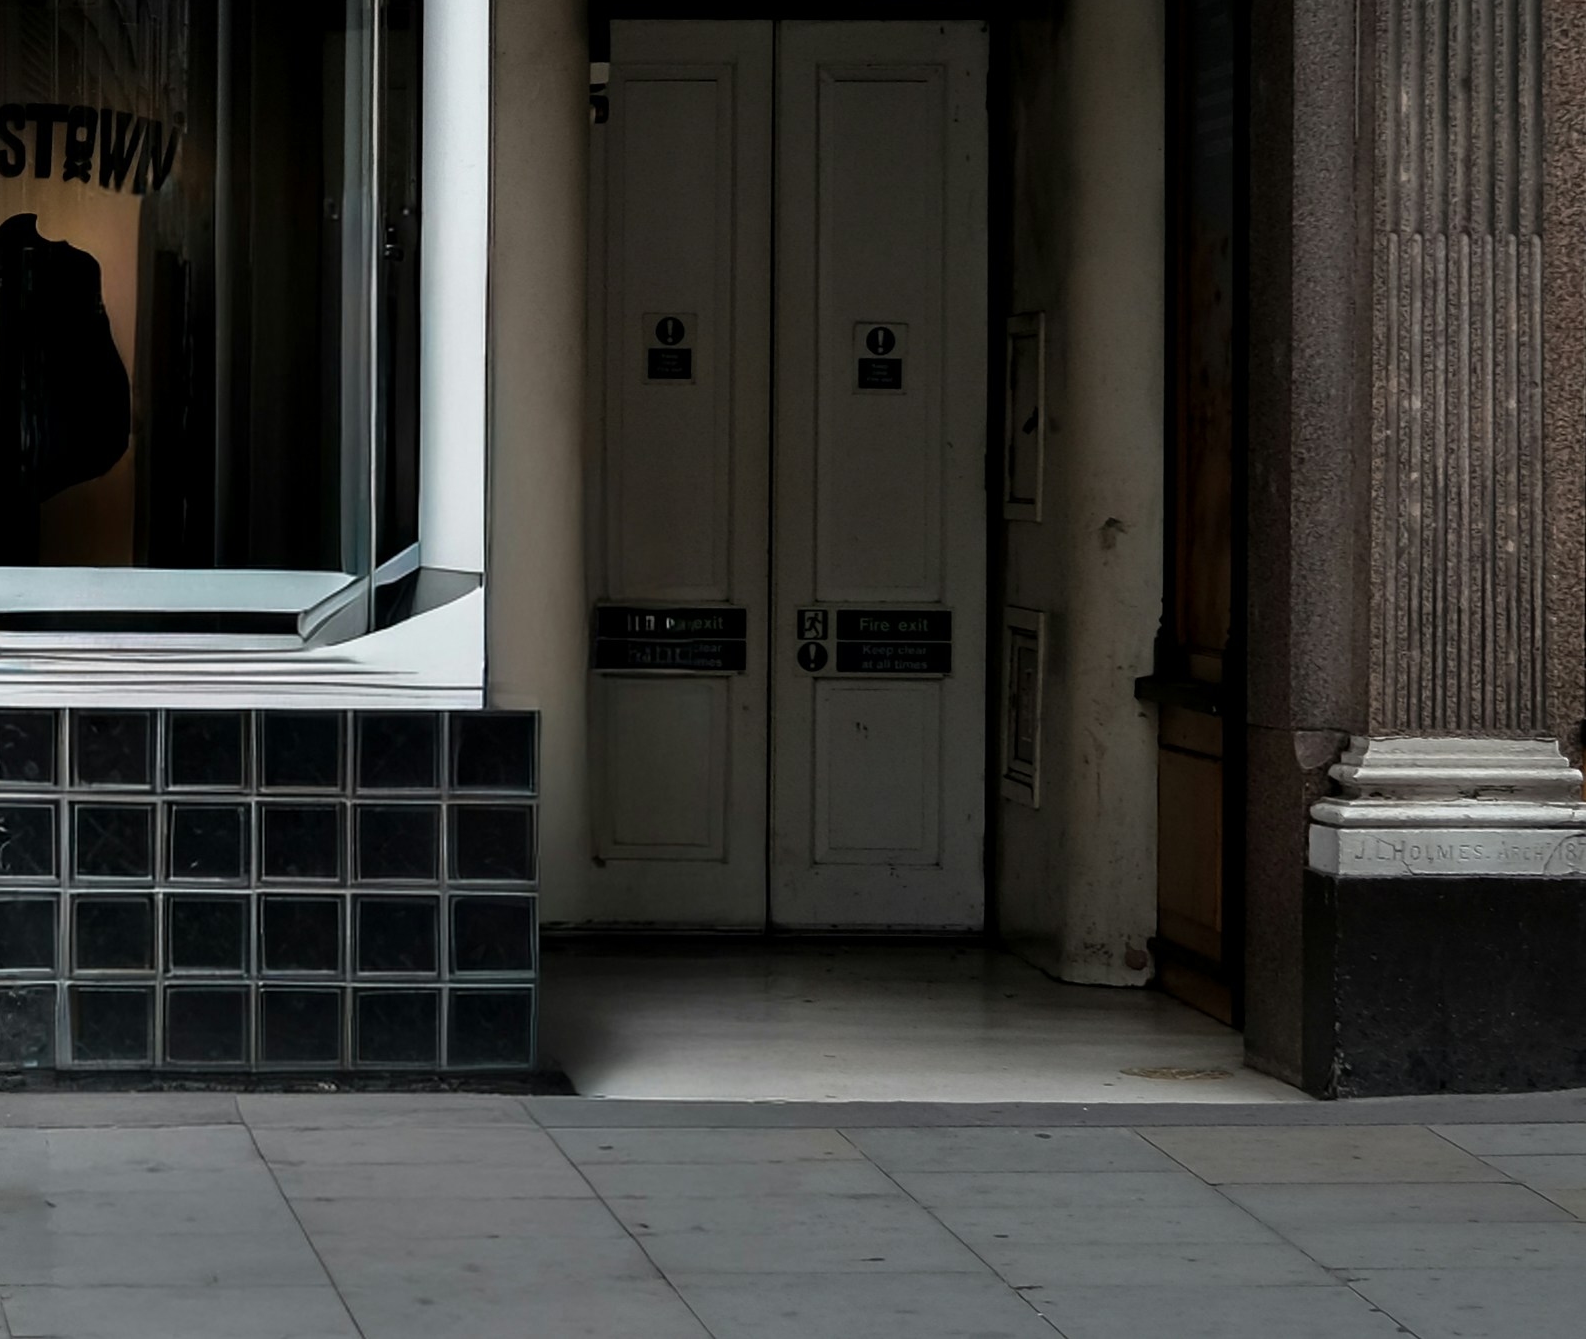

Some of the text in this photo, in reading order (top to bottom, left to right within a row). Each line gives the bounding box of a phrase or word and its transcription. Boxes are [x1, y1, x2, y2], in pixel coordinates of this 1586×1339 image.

[859, 617, 929, 632] Fire exit
[862, 644, 927, 657] Keep clear
[861, 659, 928, 670] at all times
